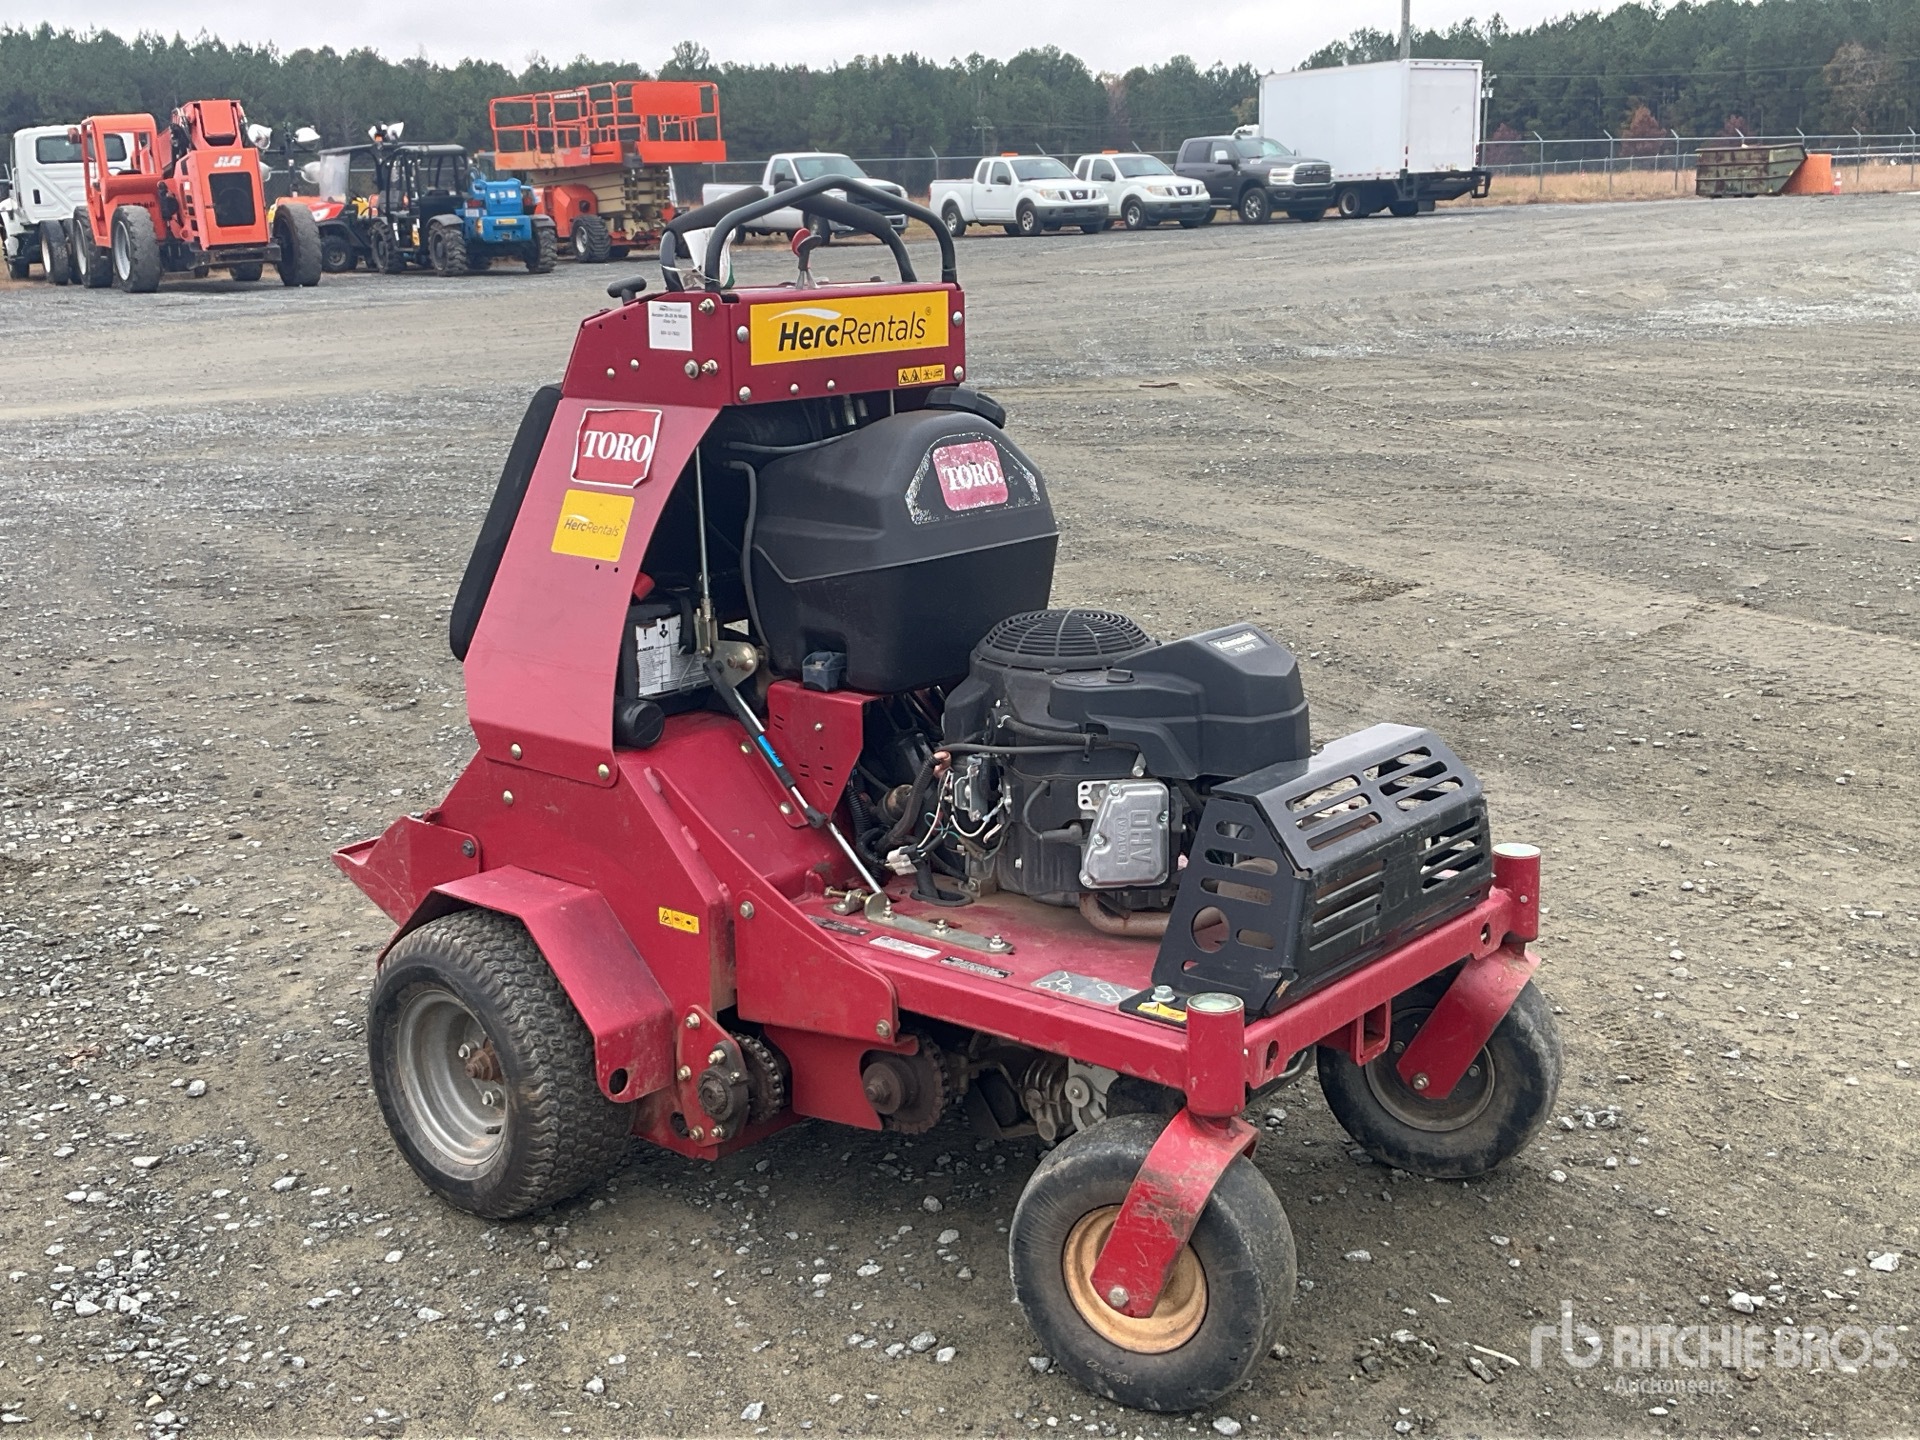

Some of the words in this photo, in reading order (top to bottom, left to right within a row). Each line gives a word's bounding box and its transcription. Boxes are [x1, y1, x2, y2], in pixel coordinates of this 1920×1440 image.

[214, 155, 242, 168] JLG
[778, 311, 927, 351] HercRentals
[582, 430, 652, 462] TORO
[564, 519, 620, 537] HercRentals
[1129, 809, 1152, 864] OHV
